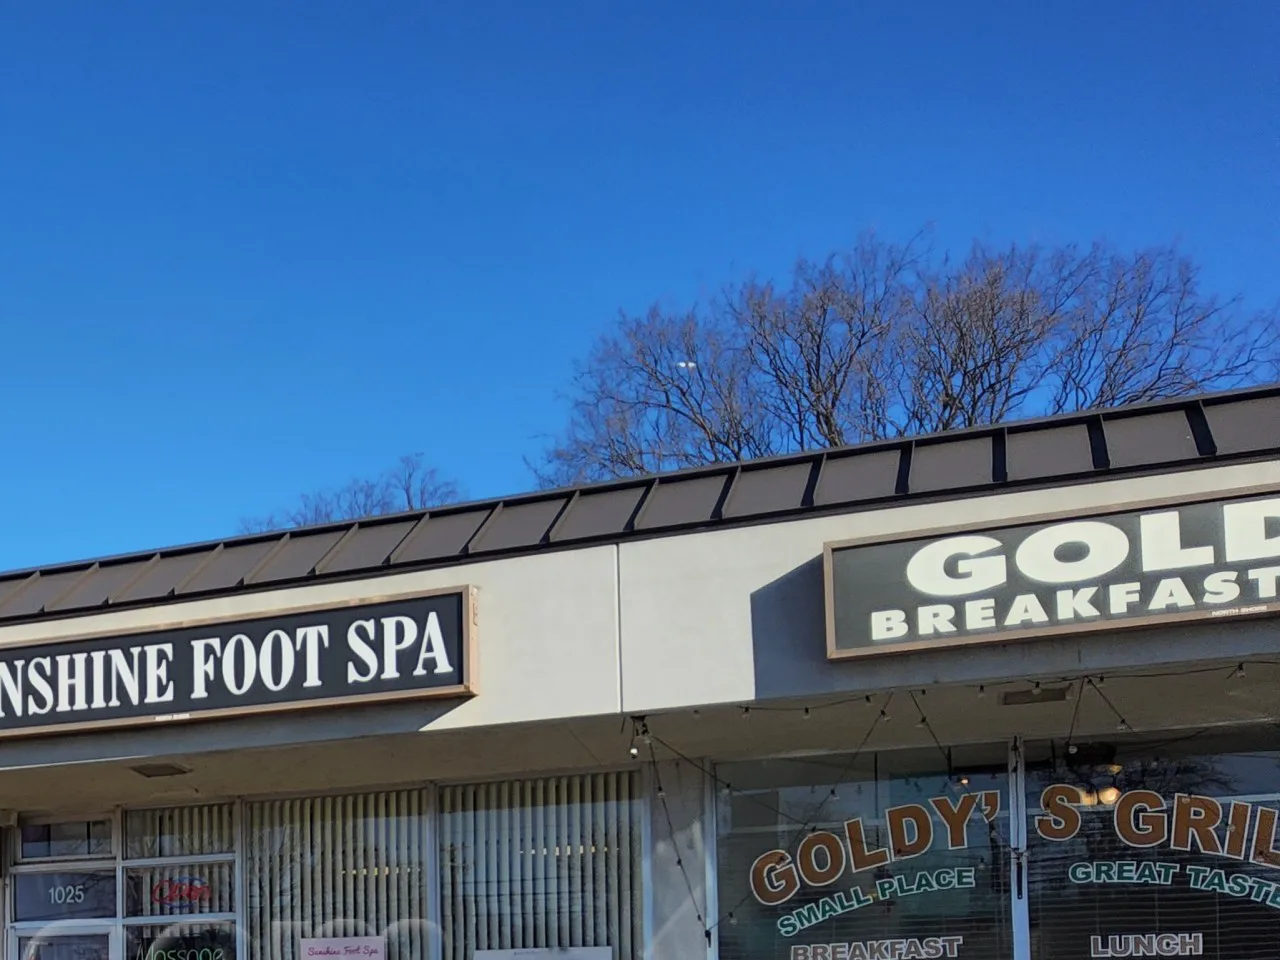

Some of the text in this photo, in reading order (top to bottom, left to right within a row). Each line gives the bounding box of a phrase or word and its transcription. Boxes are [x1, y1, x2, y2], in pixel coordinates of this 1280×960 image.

[870, 566, 1280, 642] BREAKFAST
[190, 624, 330, 699] FOOT
[346, 611, 454, 685] SPA
[1069, 860, 1180, 885] GREAT
[48, 885, 85, 904] 1025
[777, 867, 976, 938] SMALL PLACE
[308, 944, 379, 957] Sunshine Foot Spa
[1090, 933, 1203, 958] LUNCH
